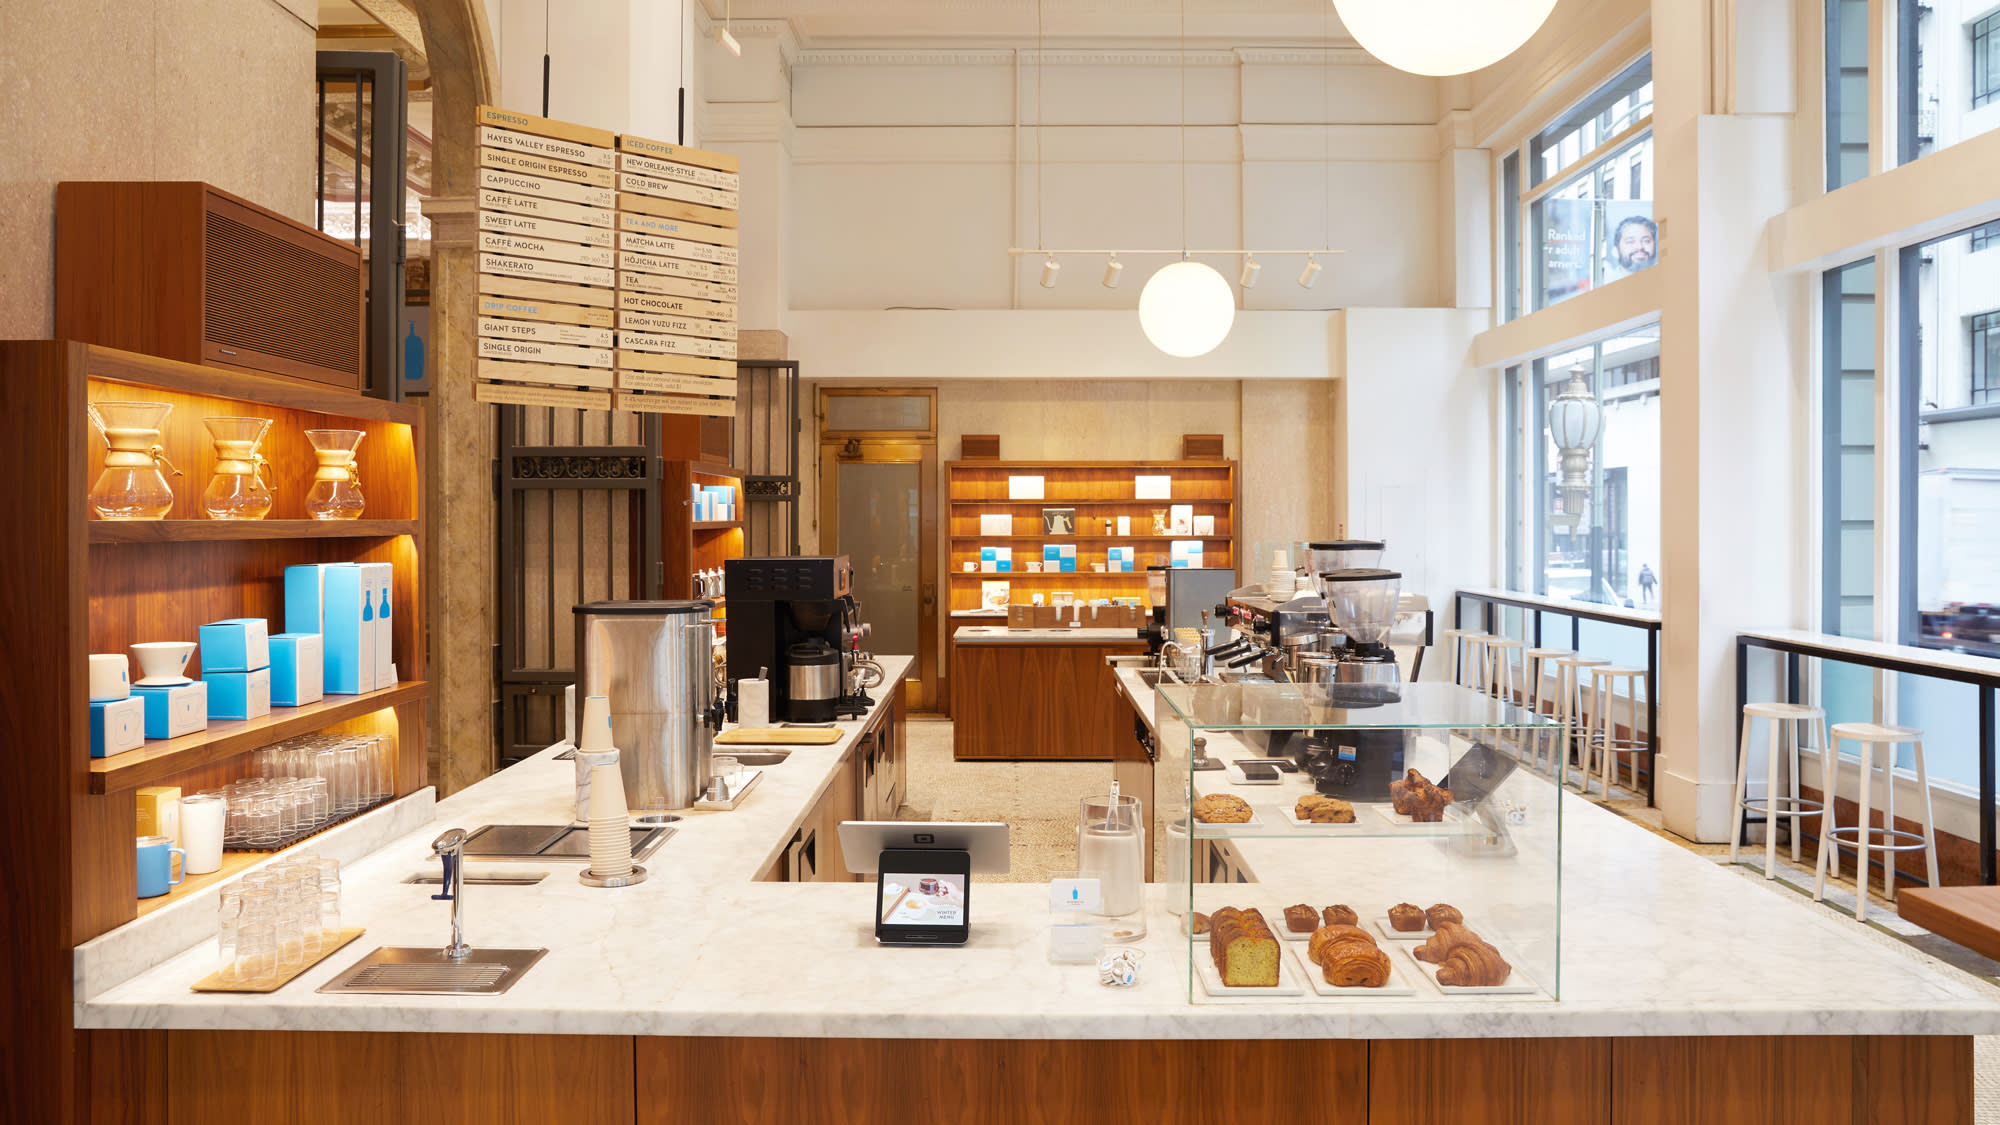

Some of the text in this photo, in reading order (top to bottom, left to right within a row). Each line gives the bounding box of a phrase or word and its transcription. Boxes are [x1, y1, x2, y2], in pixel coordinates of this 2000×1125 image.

[486, 111, 529, 126] ESPRESSO
[487, 133, 586, 158] HAYES VALLEY ESPRESSO
[627, 140, 673, 155] ICED COFFEE
[487, 154, 588, 178] SINGLE ORIGIN ESPRESSO
[626, 158, 643, 167] NEW
[644, 161, 696, 177] ORLEANS-STYLE
[487, 175, 541, 190] CAPPUCCINO
[626, 177, 646, 187] COLD
[647, 181, 668, 190] BREW
[486, 194, 512, 205] CAFFÈ
[515, 199, 537, 209] LATTE
[485, 215, 512, 226] SWEET
[514, 220, 536, 229] LATTE
[626, 218, 679, 232] TEA AND MORE
[1548, 228, 1586, 241] Ranked
[485, 237, 512, 247] CAFFÈ
[514, 241, 544, 251] MOCHA
[626, 237, 655, 247] MATCHA
[656, 241, 675, 250] LATTE
[486, 258, 534, 271] SHAKERATO
[659, 261, 680, 270] LATTE
[625, 276, 639, 284] TEA
[484, 301, 538, 314] DRIP COFFEE
[624, 297, 683, 310] HOT CHOCOLATE
[484, 323, 536, 335] GIANT STEPS
[625, 317, 687, 330] LEMON YUZU FIZZ
[483, 342, 512, 352] SINGLE
[514, 345, 541, 354] ORIGIN
[624, 337, 676, 349] CASCARA FIZZ
